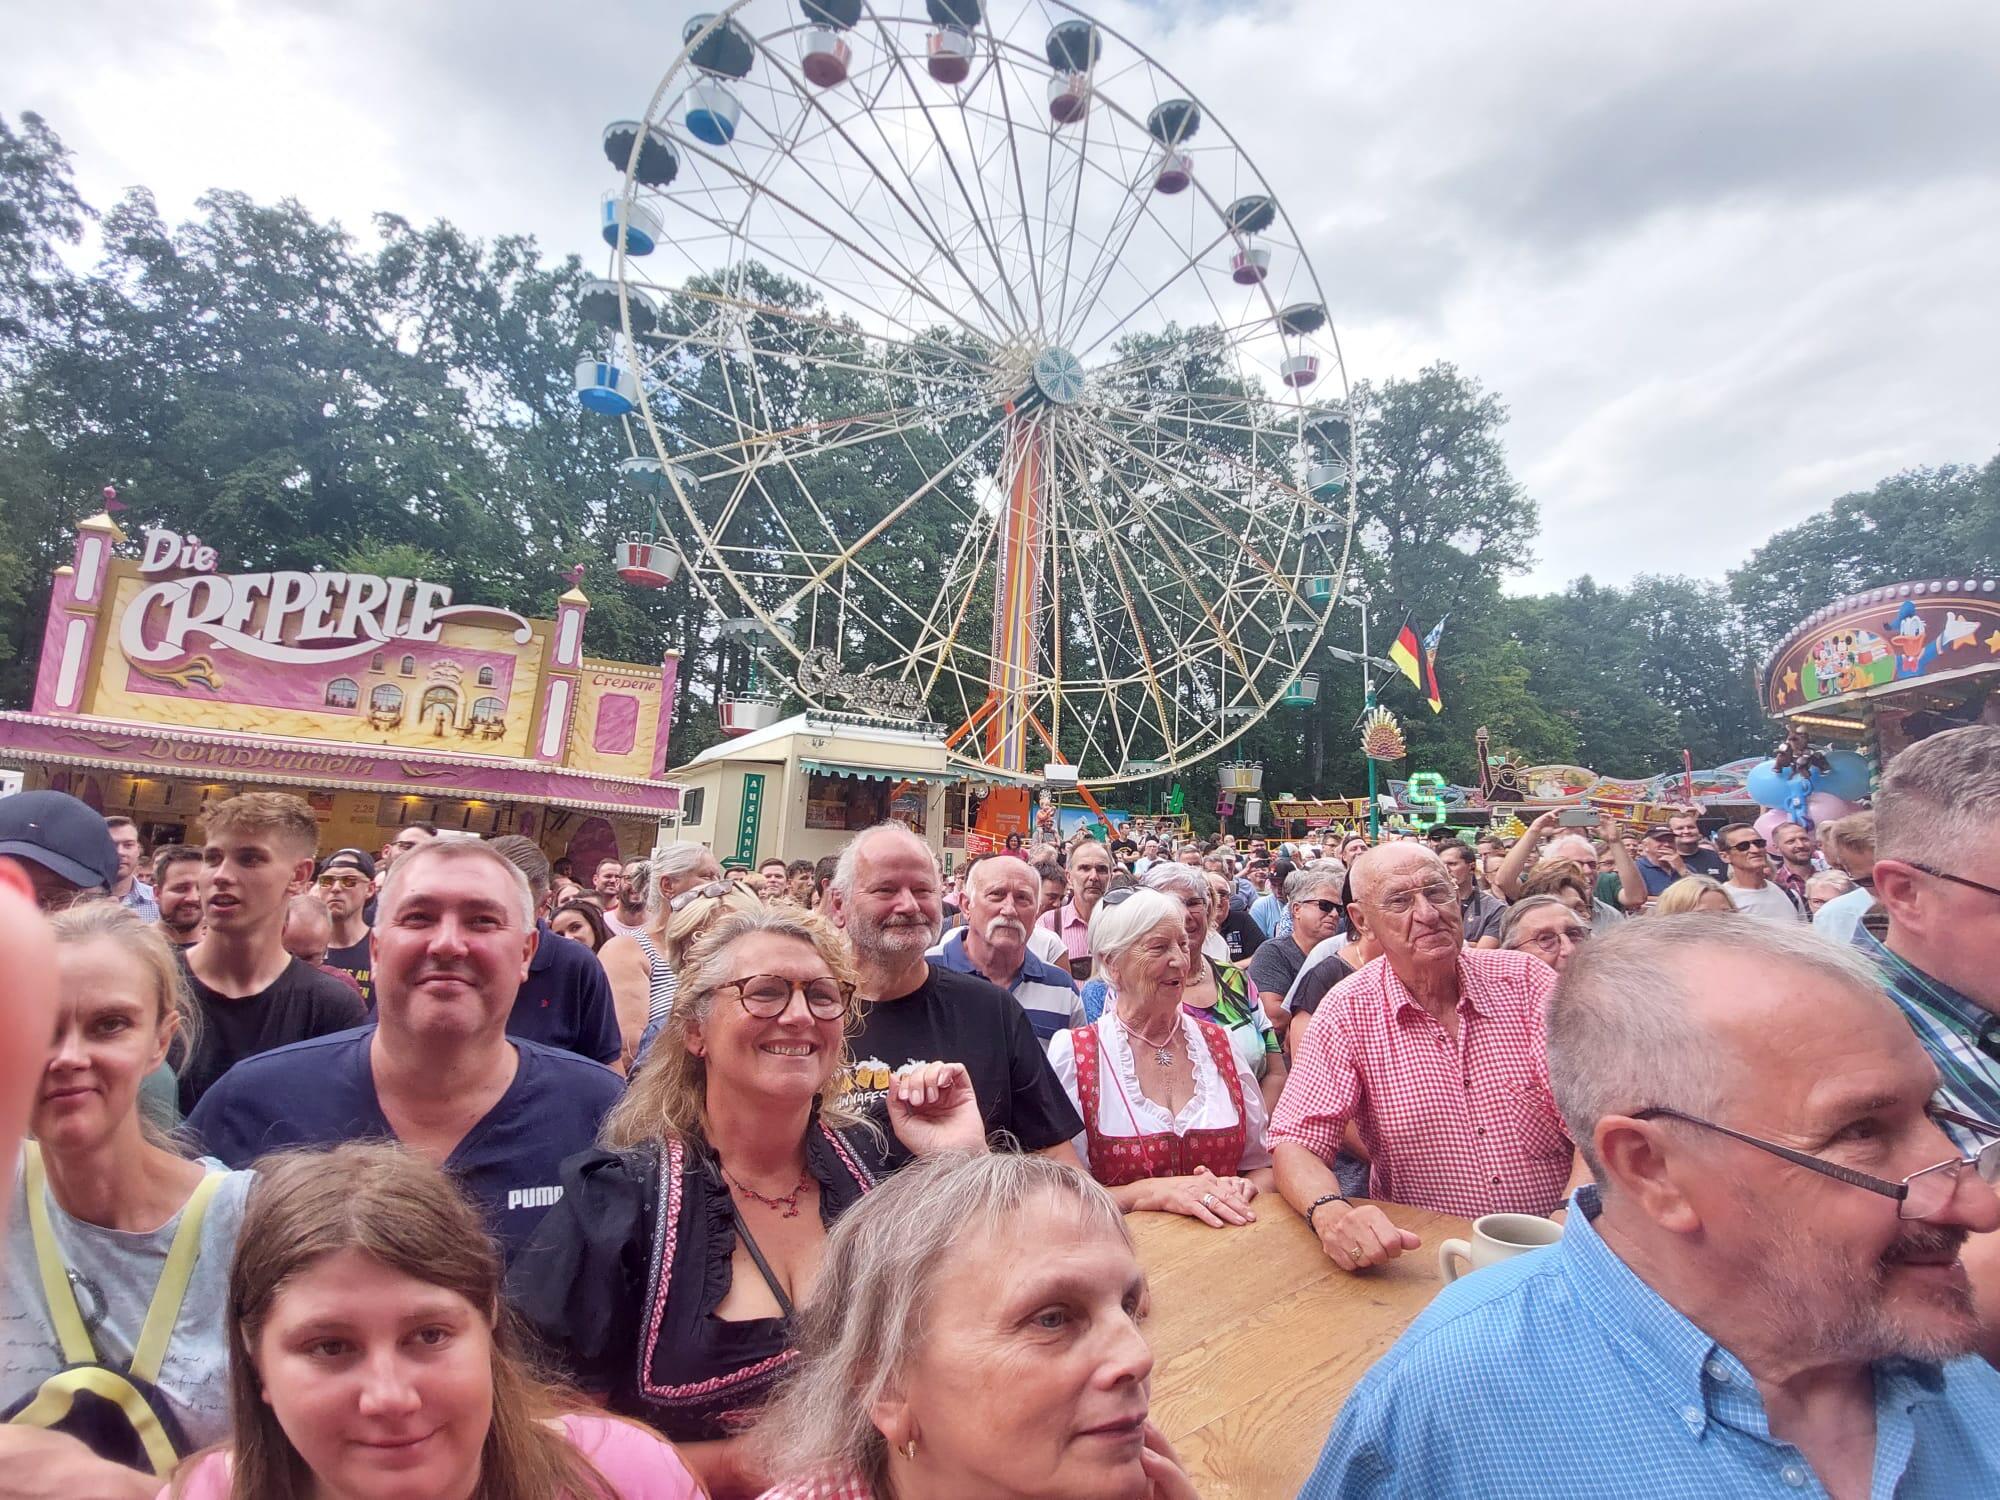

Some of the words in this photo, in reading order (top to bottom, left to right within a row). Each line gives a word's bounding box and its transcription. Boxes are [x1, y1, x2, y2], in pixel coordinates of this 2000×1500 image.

[137, 529, 217, 573] Die
[119, 571, 532, 664] CREPERIE
[592, 674, 657, 691] Creperie
[743, 780, 758, 858] AUSGANG
[508, 1185, 564, 1210] PUMA
